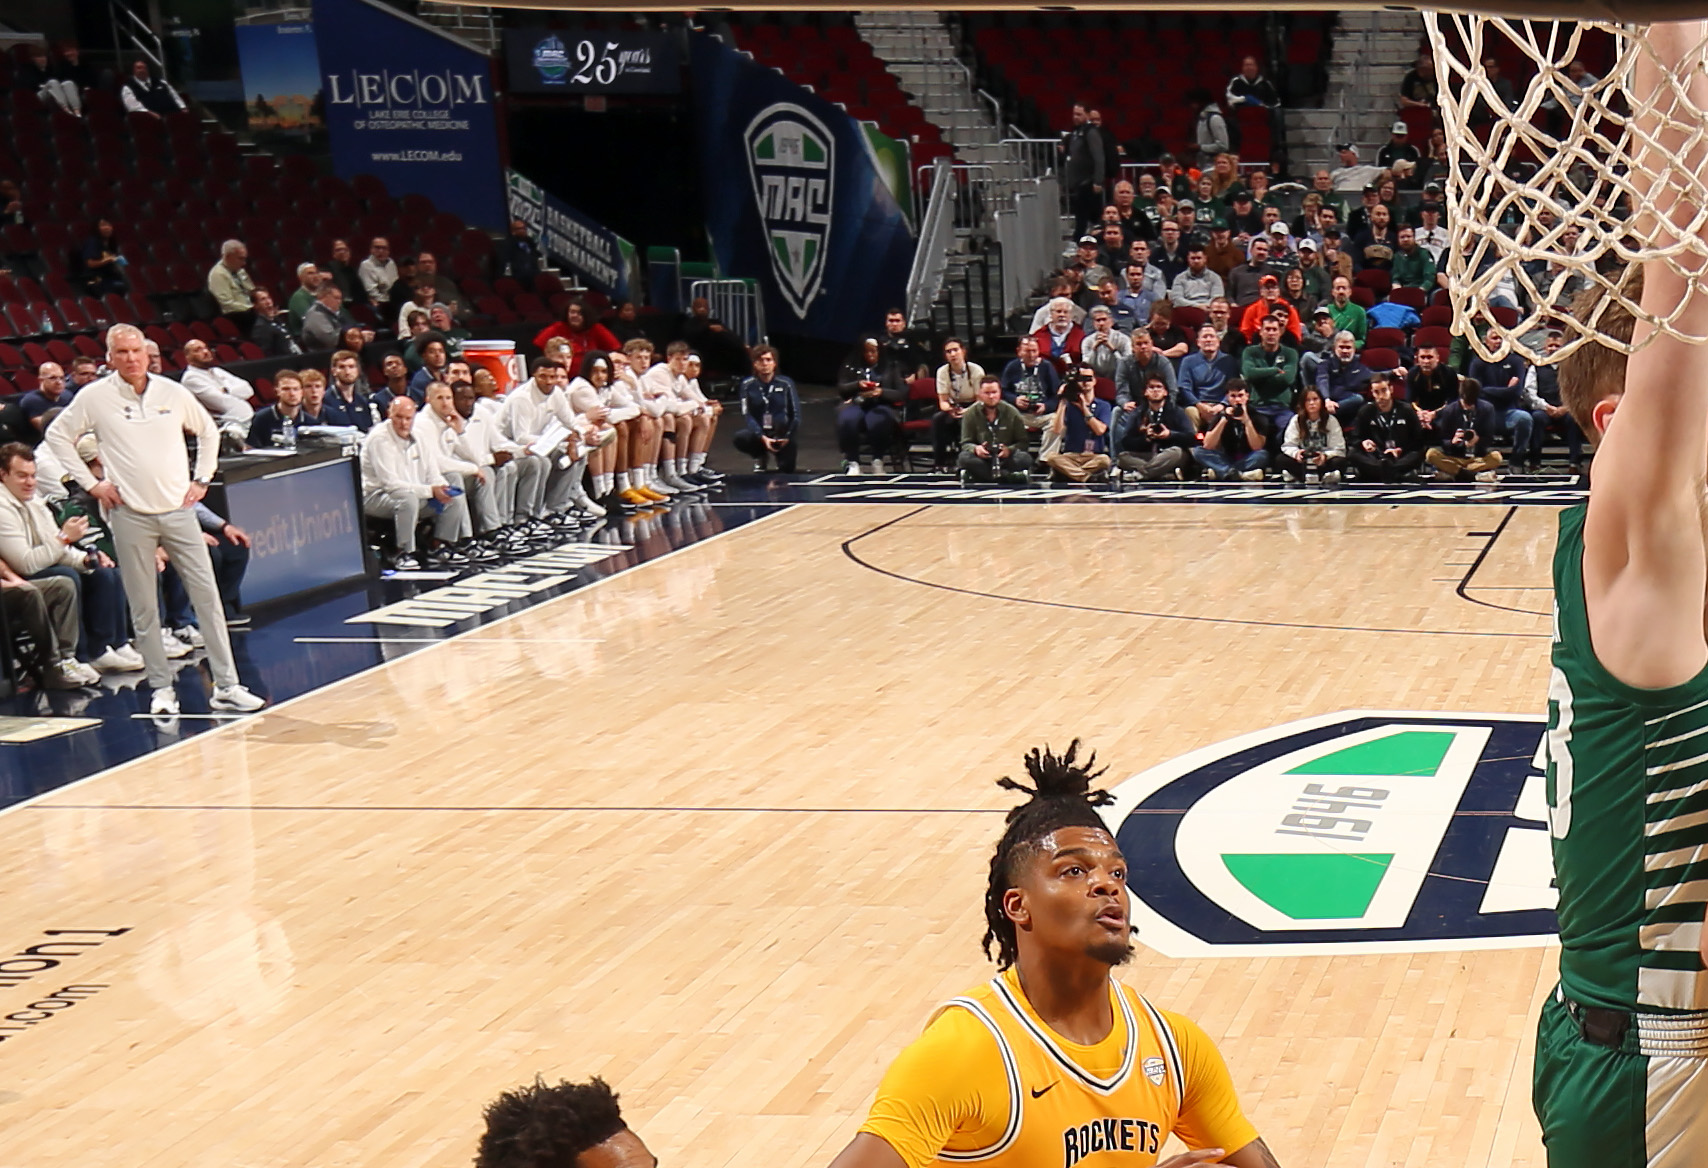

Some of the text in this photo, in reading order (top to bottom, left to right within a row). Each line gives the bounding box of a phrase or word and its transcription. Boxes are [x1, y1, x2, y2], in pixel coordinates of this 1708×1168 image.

[570, 39, 619, 84] 25
[369, 110, 391, 119] LAKE
[412, 110, 449, 119] COLLEGE
[427, 120, 469, 130] MEDICINE
[372, 151, 462, 162] www.LECOM.edu
[761, 175, 831, 224] MAC
[824, 488, 1590, 500] MID-AMERIC
[249, 513, 290, 559] redit
[344, 543, 634, 627] MACTION
[1275, 783, 1391, 842] 1946
